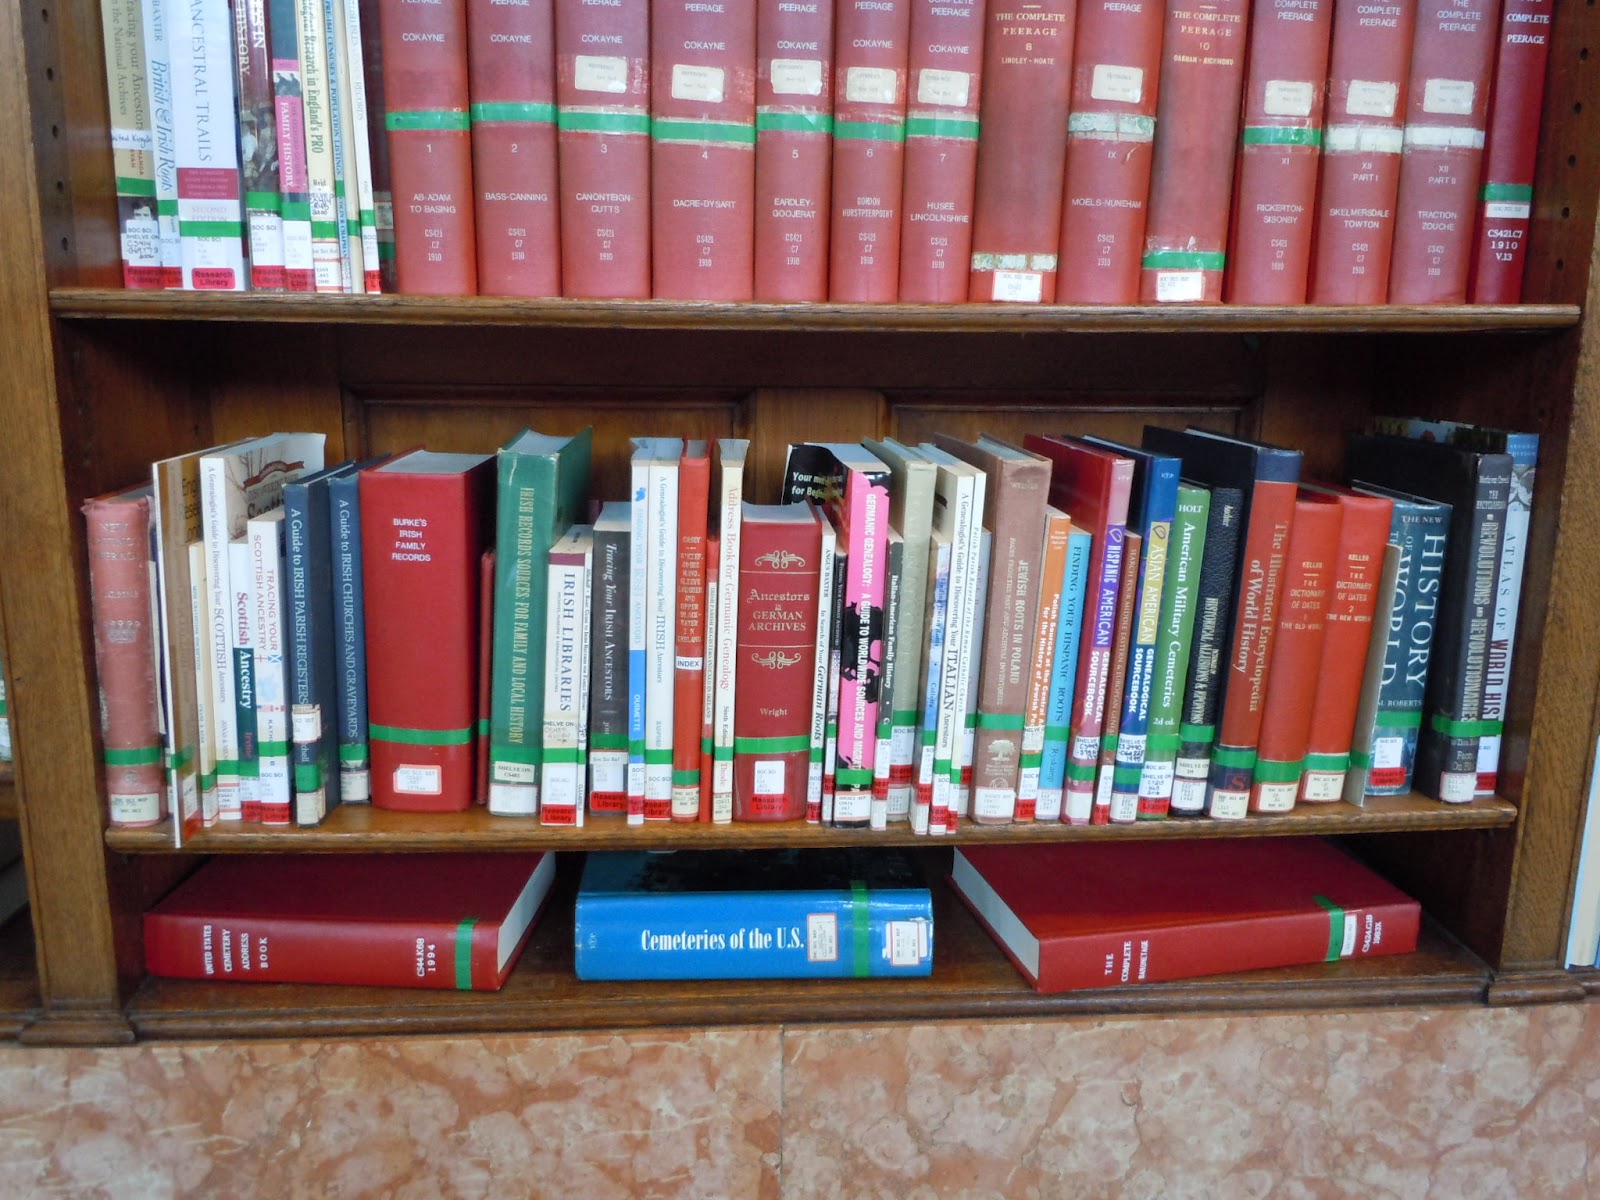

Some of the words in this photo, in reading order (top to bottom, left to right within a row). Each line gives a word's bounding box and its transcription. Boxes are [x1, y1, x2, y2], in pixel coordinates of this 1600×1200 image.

[685, 4, 724, 13] PEERAGE
[779, 3, 817, 13] PEERAGE
[855, 2, 893, 11] PEERAGE
[931, 7, 970, 17] PEERAGE
[1104, 3, 1142, 13] PEERAGE
[1278, 12, 1314, 21] PEERAGE
[1357, 6, 1400, 15] COMPLETE
[1437, 10, 1482, 20] COMPLETE
[1506, 13, 1549, 24] COMPLETE
[1003, 28, 1057, 36] PEERAGE
[1181, 26, 1232, 37] PEERAGE
[1360, 18, 1397, 27] PEERAGE
[1439, 23, 1476, 31] PEERAGE
[190, 0, 207, 96] ANCESTRAL
[402, 33, 445, 43] COKAYNE
[490, 34, 532, 43] COKAYNE
[581, 34, 623, 44] COKAYNE
[684, 41, 725, 50] COKAYNE
[777, 40, 818, 50] COKAYNE
[853, 39, 893, 48] COKAYNE
[928, 44, 969, 54] COKAYNE
[1506, 34, 1544, 44] PEERAGE
[151, 61, 168, 104] British
[156, 108, 172, 124] &
[280, 102, 289, 140] FAMILY
[157, 125, 172, 153] Irish
[196, 102, 211, 161] TRAILS
[158, 157, 175, 191] Roots
[284, 142, 293, 188] HISTORY
[485, 192, 547, 201] BASS-CANNING
[673, 199, 736, 209] DACRE-DYSART
[774, 198, 814, 207] EARDLEY-
[1072, 198, 1141, 208] MOELS-NUNEHAM
[772, 209, 816, 218] GOOJERAT
[911, 214, 969, 223] LINCOLNSHIRE
[1330, 208, 1389, 218] SKELMERSDALE
[1344, 220, 1379, 228] TOWTON
[1422, 222, 1454, 231] ZOUCHE
[291, 508, 301, 517] A
[339, 500, 348, 508] A
[520, 487, 534, 512] IRISH
[727, 487, 738, 529] Address
[1179, 504, 1203, 513] HOLT
[340, 510, 350, 539] Guide
[865, 494, 876, 535] GERMANIC
[1401, 515, 1421, 523] THE
[1423, 516, 1443, 524] NEW
[292, 520, 303, 551] Guide
[341, 541, 349, 550] to
[396, 542, 425, 550] FAMILY
[400, 530, 422, 538] IRISH
[518, 515, 533, 555] RECORDS
[726, 533, 736, 561] Book
[1272, 522, 1287, 549] The
[254, 535, 263, 589] SCOTTISH
[293, 553, 302, 564] to
[392, 553, 431, 562] RECORDS
[603, 543, 617, 581] Tracing
[862, 538, 873, 587] GENEALOGY:
[1104, 545, 1121, 582] HISPANIC
[1148, 544, 1164, 581] ASIAN
[1177, 522, 1195, 582] American
[1473, 522, 1498, 605] REVOLUTIONS
[1498, 532, 1516, 597] ATLAS
[342, 553, 352, 582] IRISH
[725, 563, 735, 579] for
[1017, 560, 1029, 596] JEWISH
[1069, 546, 1082, 591] FINDING
[1250, 560, 1264, 574] of
[267, 570, 275, 618] TRACING
[293, 567, 304, 598] IRISH
[563, 573, 575, 619] IRISH
[605, 584, 617, 607] Your
[747, 589, 810, 603] Ancestors
[1262, 553, 1284, 621] Illustrated
[1290, 589, 1324, 597] DICTIONARY
[1336, 581, 1372, 590] DICTIONARY
[515, 602, 530, 619] FOR
[723, 582, 734, 634] Germanic
[859, 601, 871, 623] GUIDE
[888, 575, 898, 634] Italian-American
[1065, 597, 1076, 626] YOUR
[1168, 587, 1188, 637] Military
[1245, 578, 1263, 618] World
[1405, 532, 1446, 688] HISTORY
[237, 592, 249, 645] Scottish
[256, 592, 266, 650] ANCESTRY
[295, 601, 306, 643] PARISH
[343, 583, 354, 642] CHURCHES
[605, 609, 616, 637] IRISH
[753, 611, 803, 620] GERMAN
[1013, 600, 1026, 630] ROOTS
[1096, 589, 1114, 645] AMERICAN
[1140, 586, 1158, 642] AMERICAN
[1496, 606, 1509, 631] OF
[269, 622, 277, 650] YOUR
[513, 622, 528, 653] FAMILY
[749, 623, 806, 631] ARCHIVES
[859, 626, 869, 635] TO
[1012, 633, 1023, 643] IN
[345, 644, 355, 668] AND
[857, 638, 868, 684] WORLDWIDE
[886, 637, 895, 661] Family
[1060, 632, 1072, 681] HISPANIC
[1232, 623, 1257, 673] History
[297, 645, 308, 704] REGISTERS
[512, 656, 526, 674] AND
[560, 627, 573, 712] LIBRARIES
[604, 641, 615, 700] ANCESTORS
[720, 638, 732, 691] Genealogy
[885, 663, 895, 688] History
[1009, 647, 1022, 683] POLAND
[1162, 641, 1181, 708] Cemeteries
[1249, 626, 1270, 712] Encyclopedia
[1460, 618, 1489, 722] REVOLUTIONARIES
[1485, 639, 1509, 691] WORLD
[240, 650, 252, 709] Ancestry
[511, 677, 526, 703] LOCAL
[1084, 650, 1099, 716] SOURCEBOOK
[1095, 651, 1111, 724] GENEALOGICAL
[1128, 648, 1144, 713] SOURCEBOOK
[1138, 648, 1155, 721] GENEALOGICAL
[347, 670, 357, 738] GRAVEYARDS
[760, 708, 787, 716] Wright
[855, 686, 866, 720] SOURCES
[1055, 687, 1066, 722] ROOTS
[1482, 692, 1501, 721] HIST
[509, 706, 525, 744] HISTORY
[854, 722, 864, 738] AND
[203, 925, 212, 947] STATES
[222, 928, 232, 972] CEMETERY
[641, 929, 726, 951] Cemeteries
[729, 929, 745, 949] of
[748, 927, 772, 949] the
[777, 927, 804, 948] U.S.
[205, 947, 214, 974] UNITED
[241, 933, 251, 970] ADDRESS
[260, 937, 268, 969] BOOK
[427, 944, 436, 972] 1994
[1104, 953, 1114, 975] THE
[1120, 941, 1131, 982] COMPLETE
[1138, 940, 1148, 980] BARONETAGE
